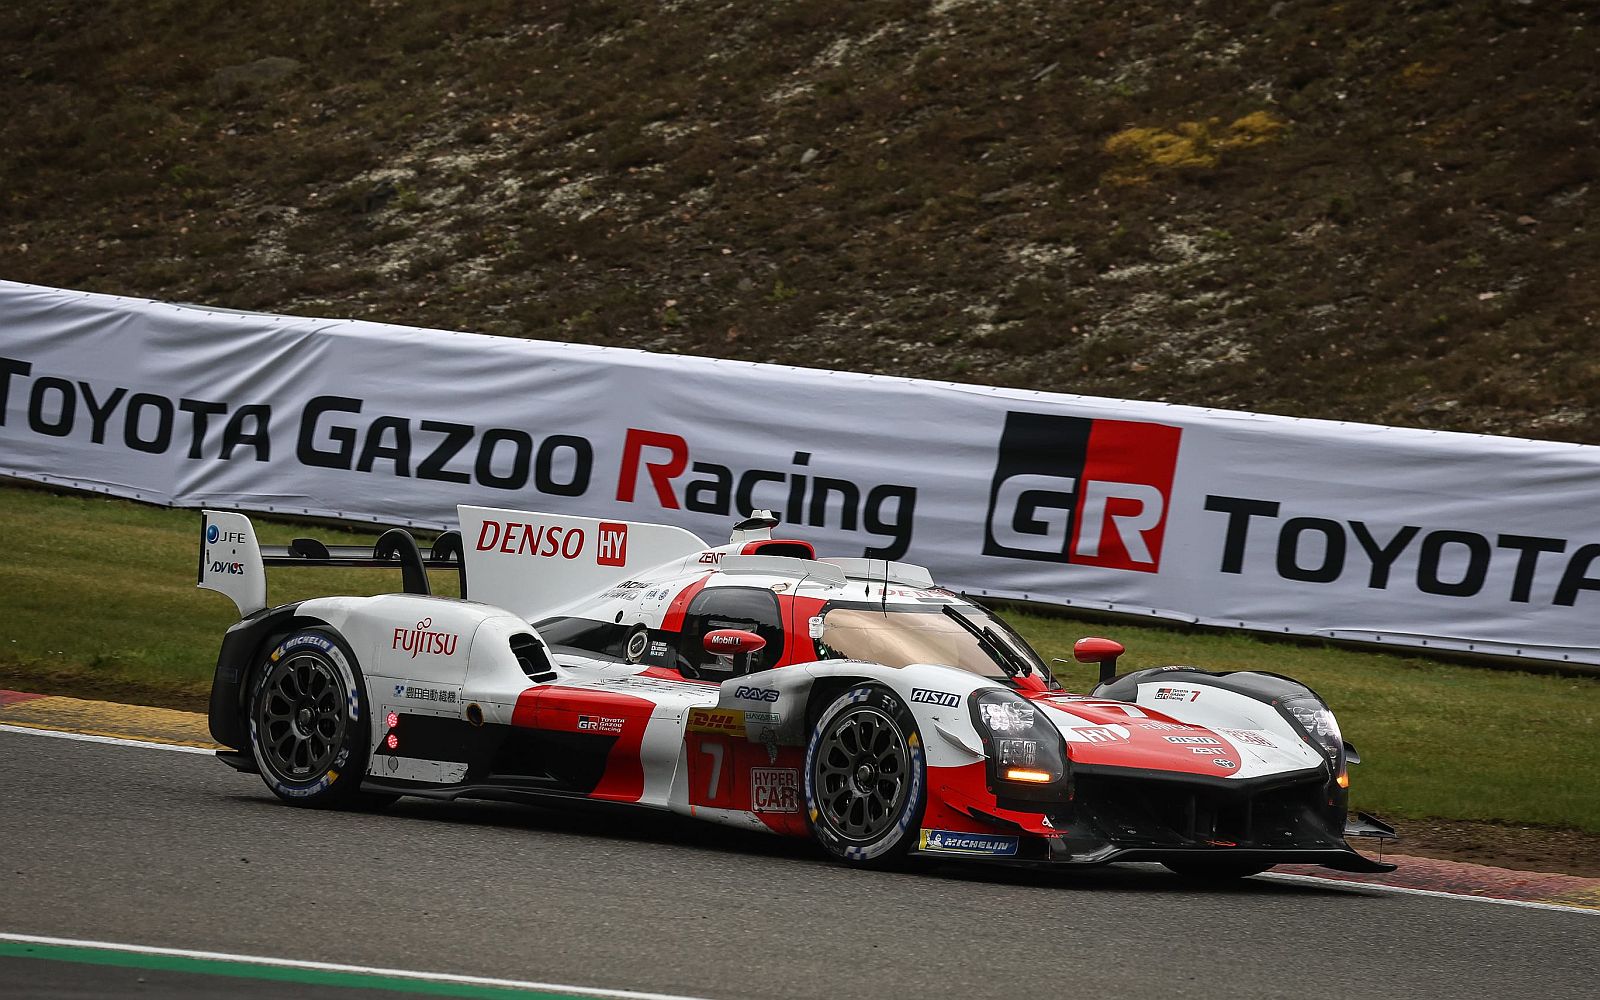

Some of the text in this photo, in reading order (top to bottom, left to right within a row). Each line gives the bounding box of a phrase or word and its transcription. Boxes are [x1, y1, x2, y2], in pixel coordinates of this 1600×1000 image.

[0, 357, 917, 562] TOYOTA GAZOO Racing
[990, 473, 1164, 565] GR
[220, 531, 246, 544] JFE
[476, 520, 625, 560] DENSO HY
[698, 552, 727, 564] ZENT
[285, 635, 332, 650] MICHELIN
[392, 628, 458, 659] FUJITSU
[711, 635, 732, 645] Mobil
[736, 687, 779, 702] RAYS
[911, 689, 960, 707] AISIN
[1190, 690, 1201, 702] 7
[600, 716, 625, 724] TOYOTA
[693, 712, 737, 730] DHL
[1077, 727, 1118, 743] HY
[701, 742, 724, 800] 7
[754, 772, 795, 786] HYPER
[755, 786, 797, 808] CAR
[944, 838, 1009, 850] MICHELIN
